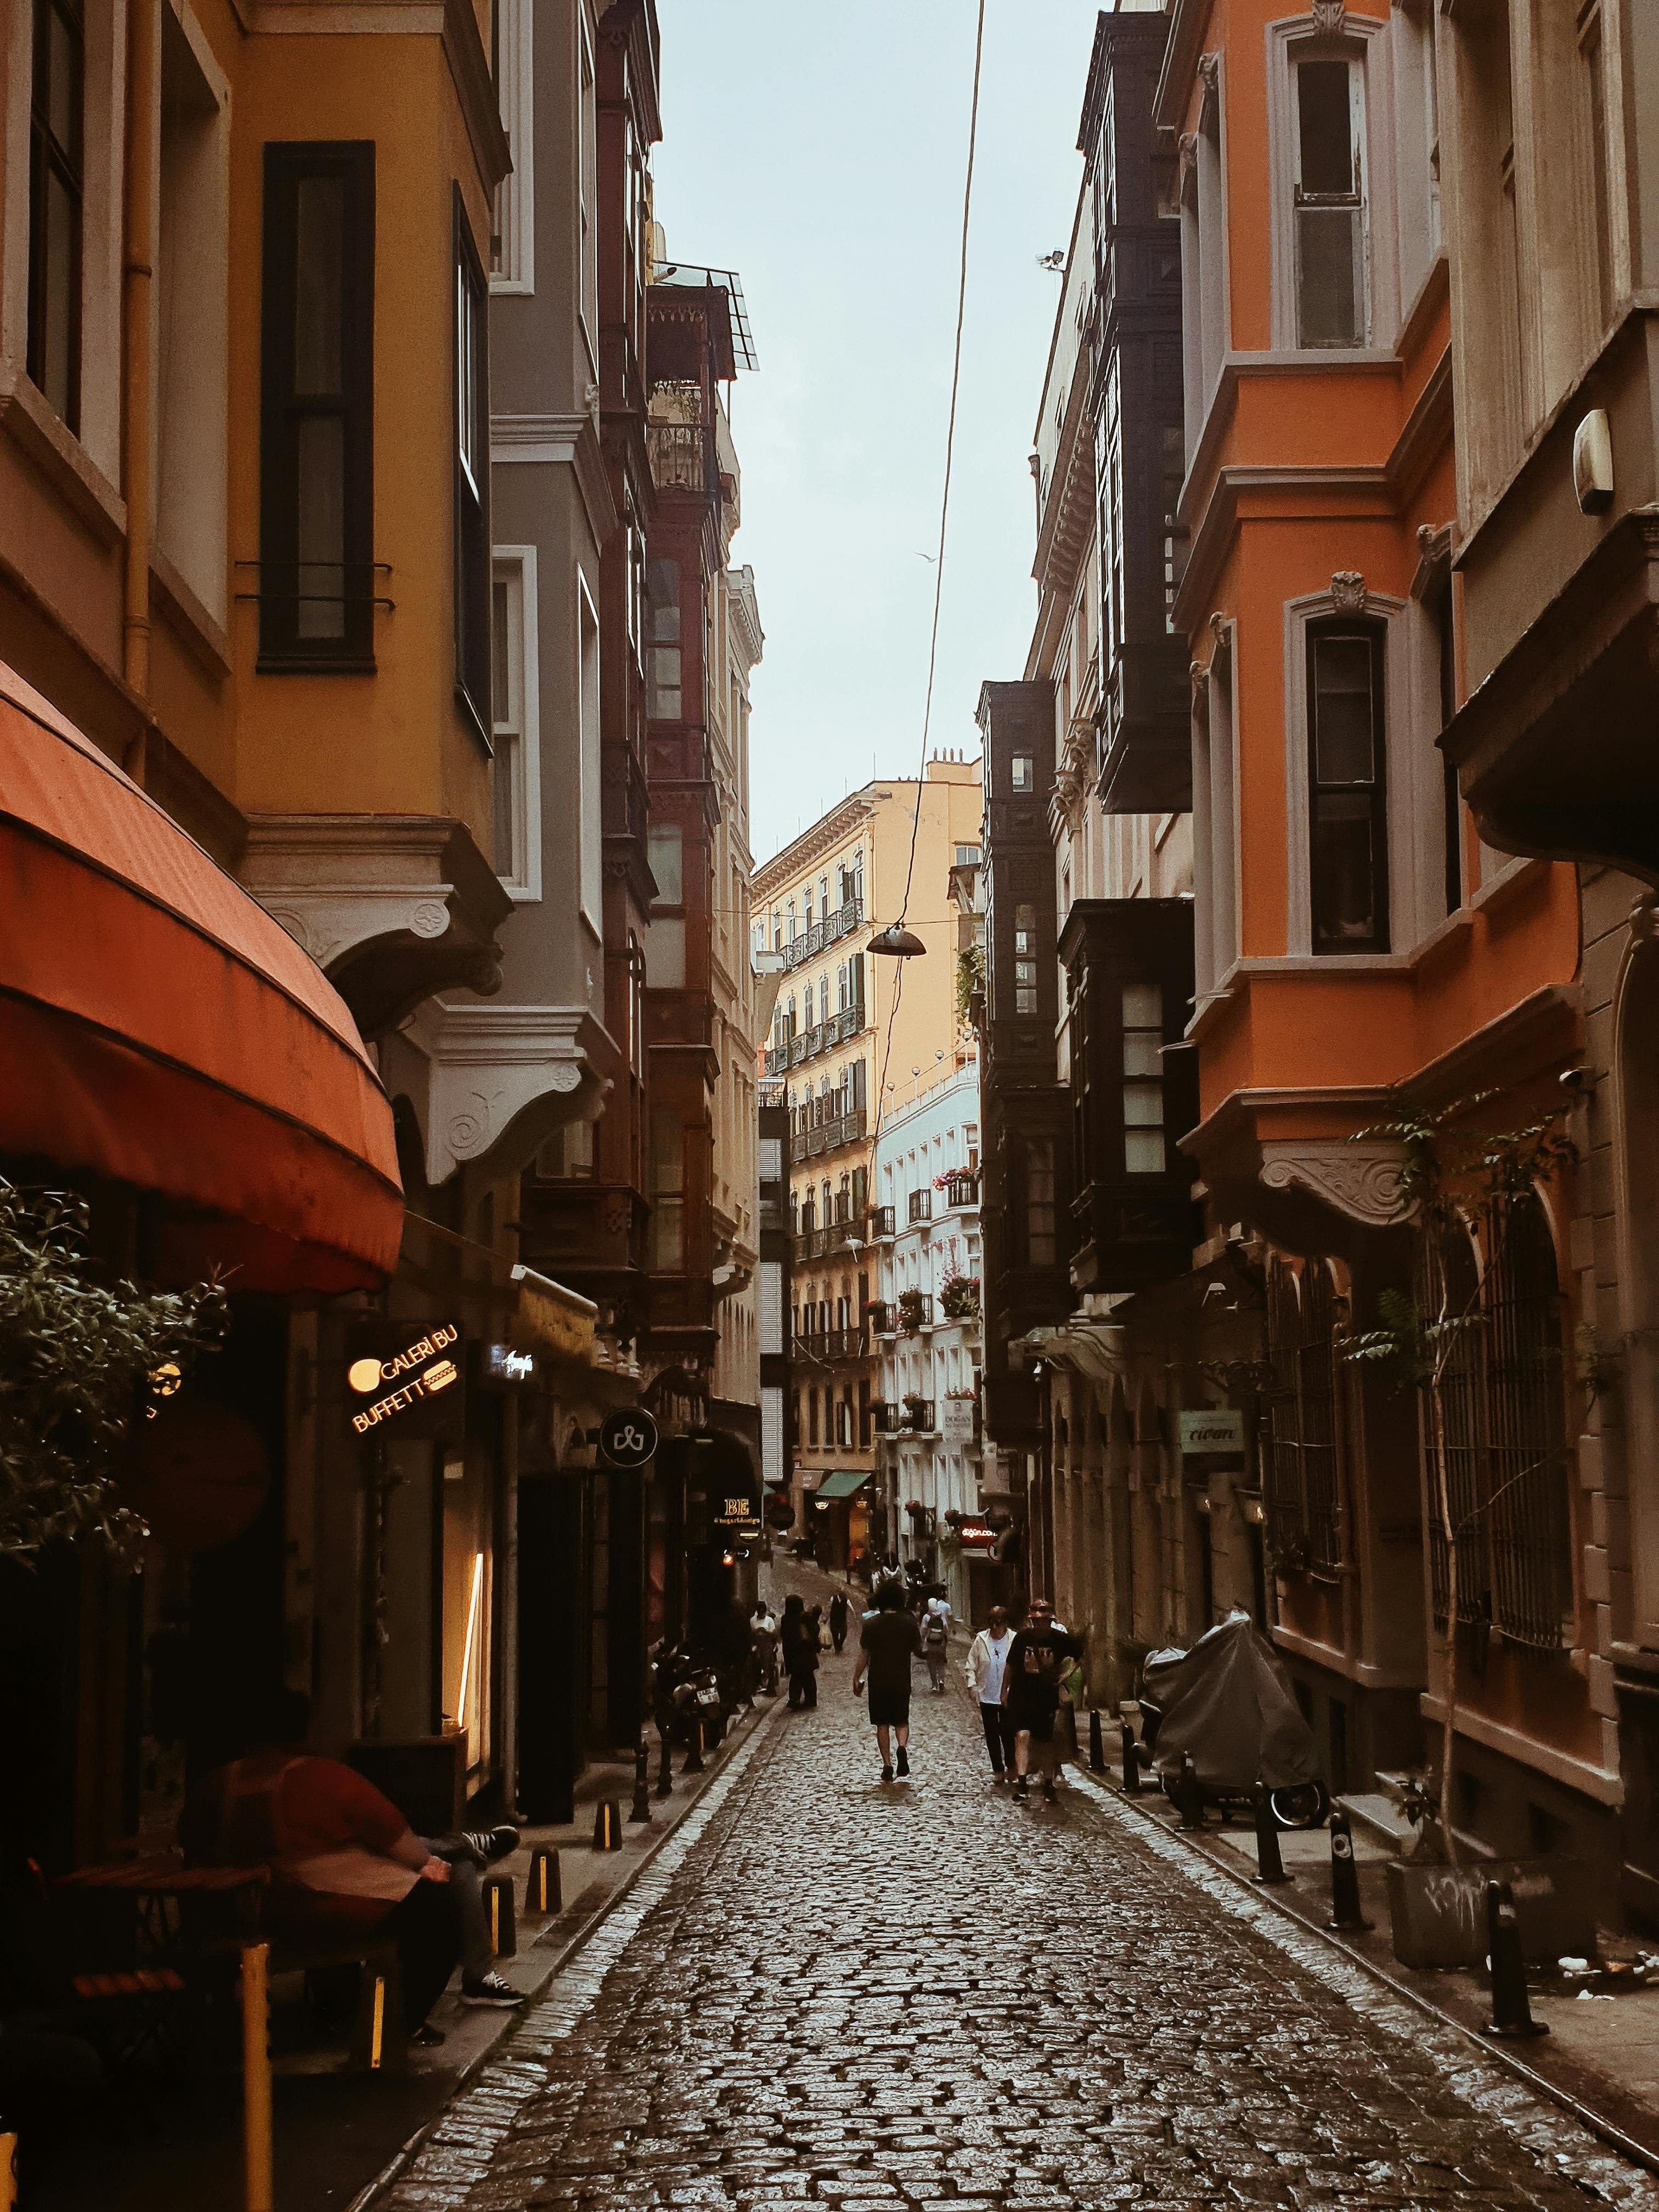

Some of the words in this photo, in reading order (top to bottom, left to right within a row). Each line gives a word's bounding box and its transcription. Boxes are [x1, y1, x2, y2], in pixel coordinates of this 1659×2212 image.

[381, 1336, 436, 1379] GALERİ
[432, 1324, 458, 1348] BU
[352, 1378, 424, 1432] BUFFETT
